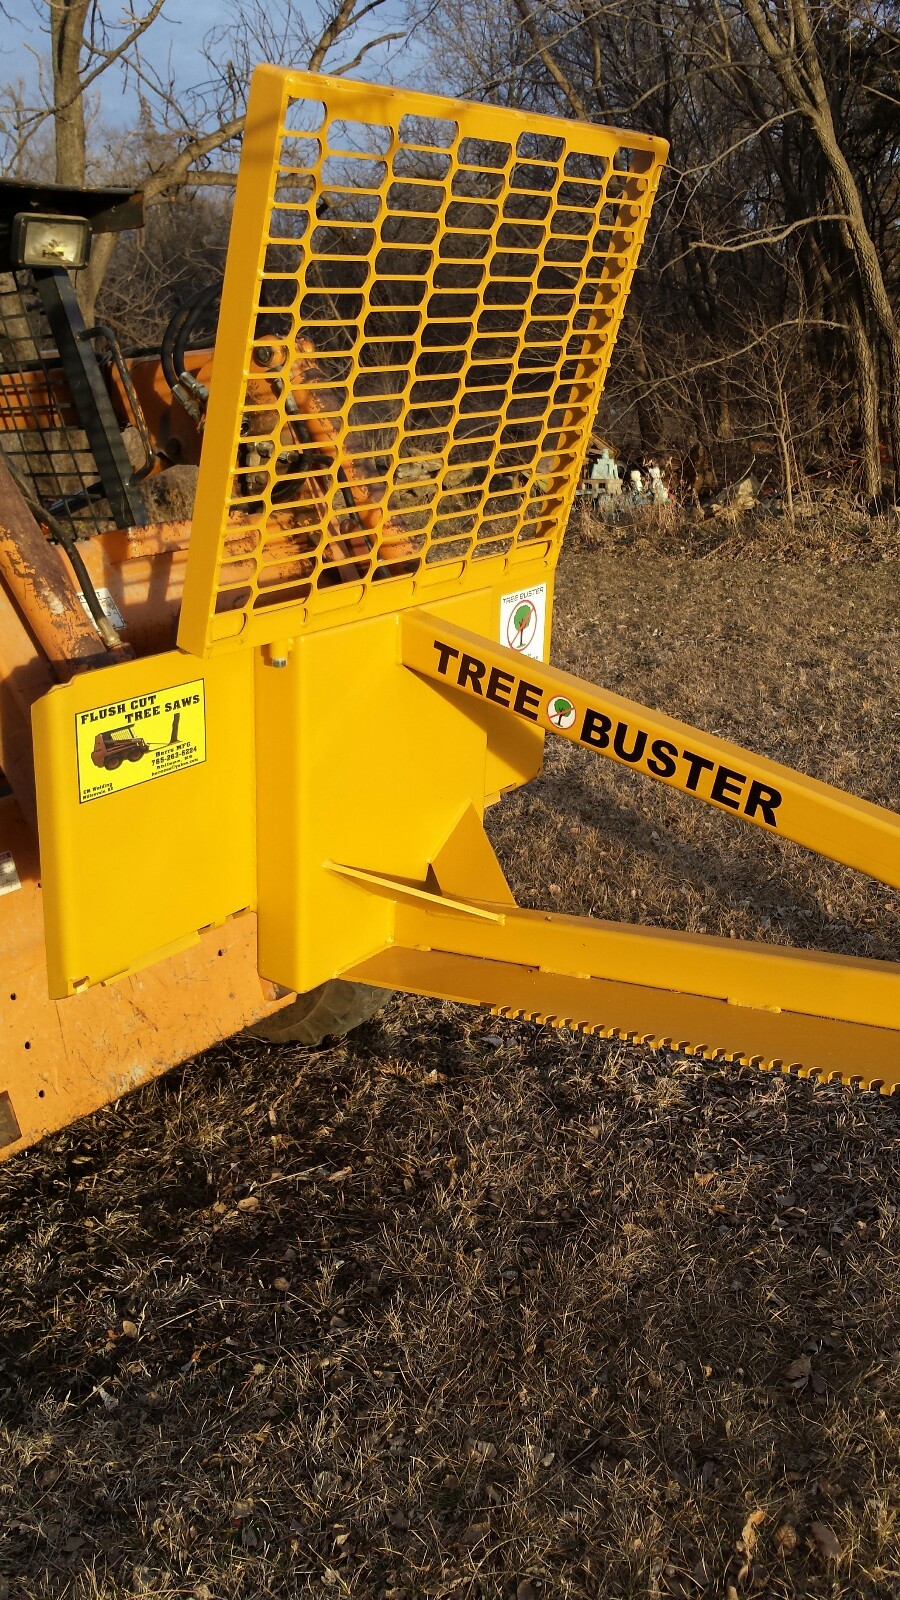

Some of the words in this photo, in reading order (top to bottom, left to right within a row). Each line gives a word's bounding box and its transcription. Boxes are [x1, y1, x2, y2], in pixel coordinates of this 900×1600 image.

[502, 594, 519, 604] TREE
[520, 586, 544, 600] BUSTER
[81, 703, 126, 725] FLUSH
[130, 695, 157, 711] CUT
[125, 705, 161, 723] TREE
[165, 694, 200, 712] SAWS
[433, 640, 543, 721] TREE
[580, 708, 783, 827] BUSTER
